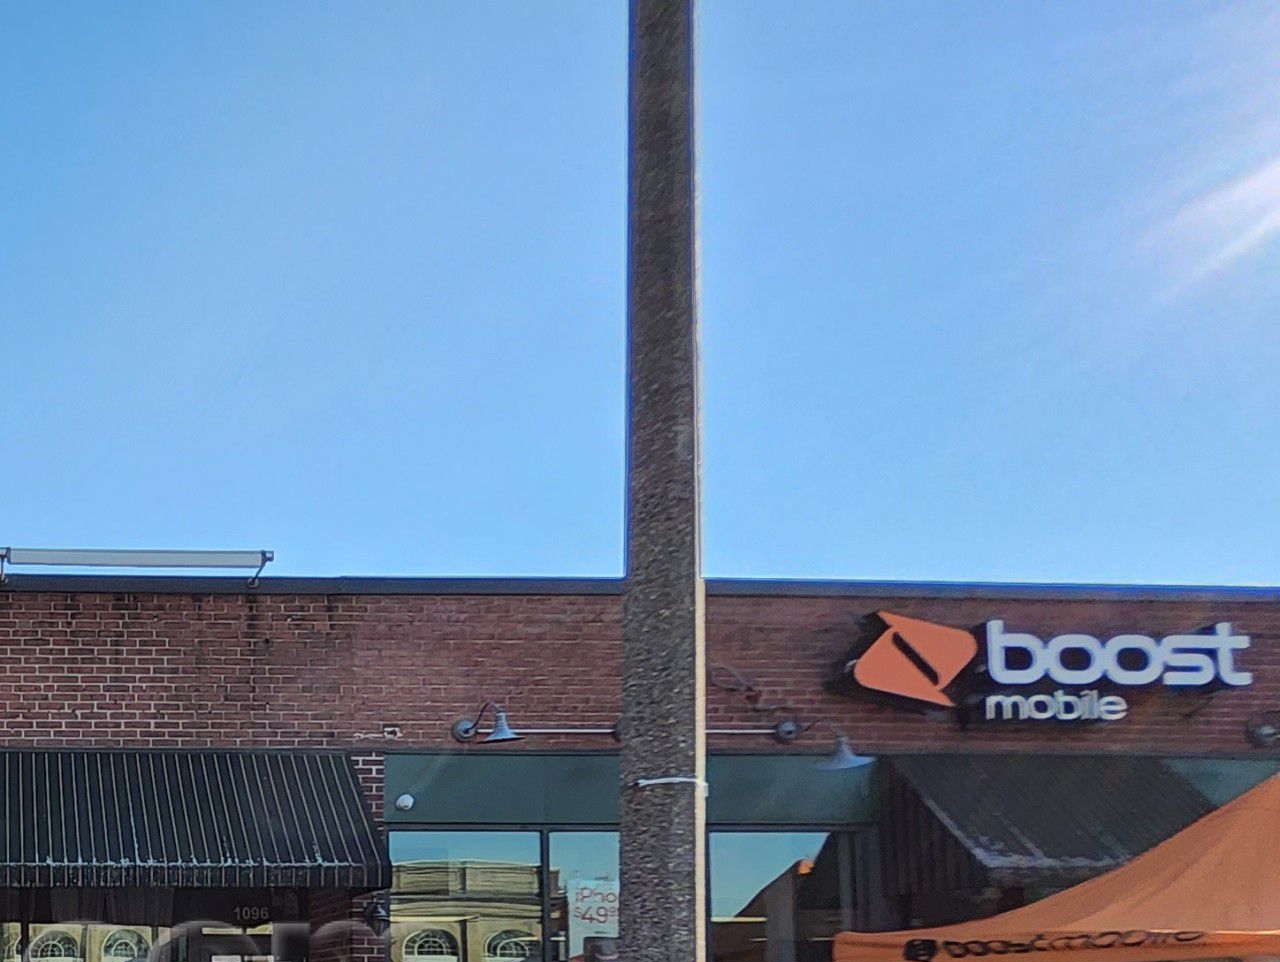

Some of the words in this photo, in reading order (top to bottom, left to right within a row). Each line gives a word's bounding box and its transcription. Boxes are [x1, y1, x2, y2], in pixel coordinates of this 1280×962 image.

[986, 619, 1254, 686] boost
[986, 690, 1129, 720] mobile
[233, 906, 270, 920] 1096
